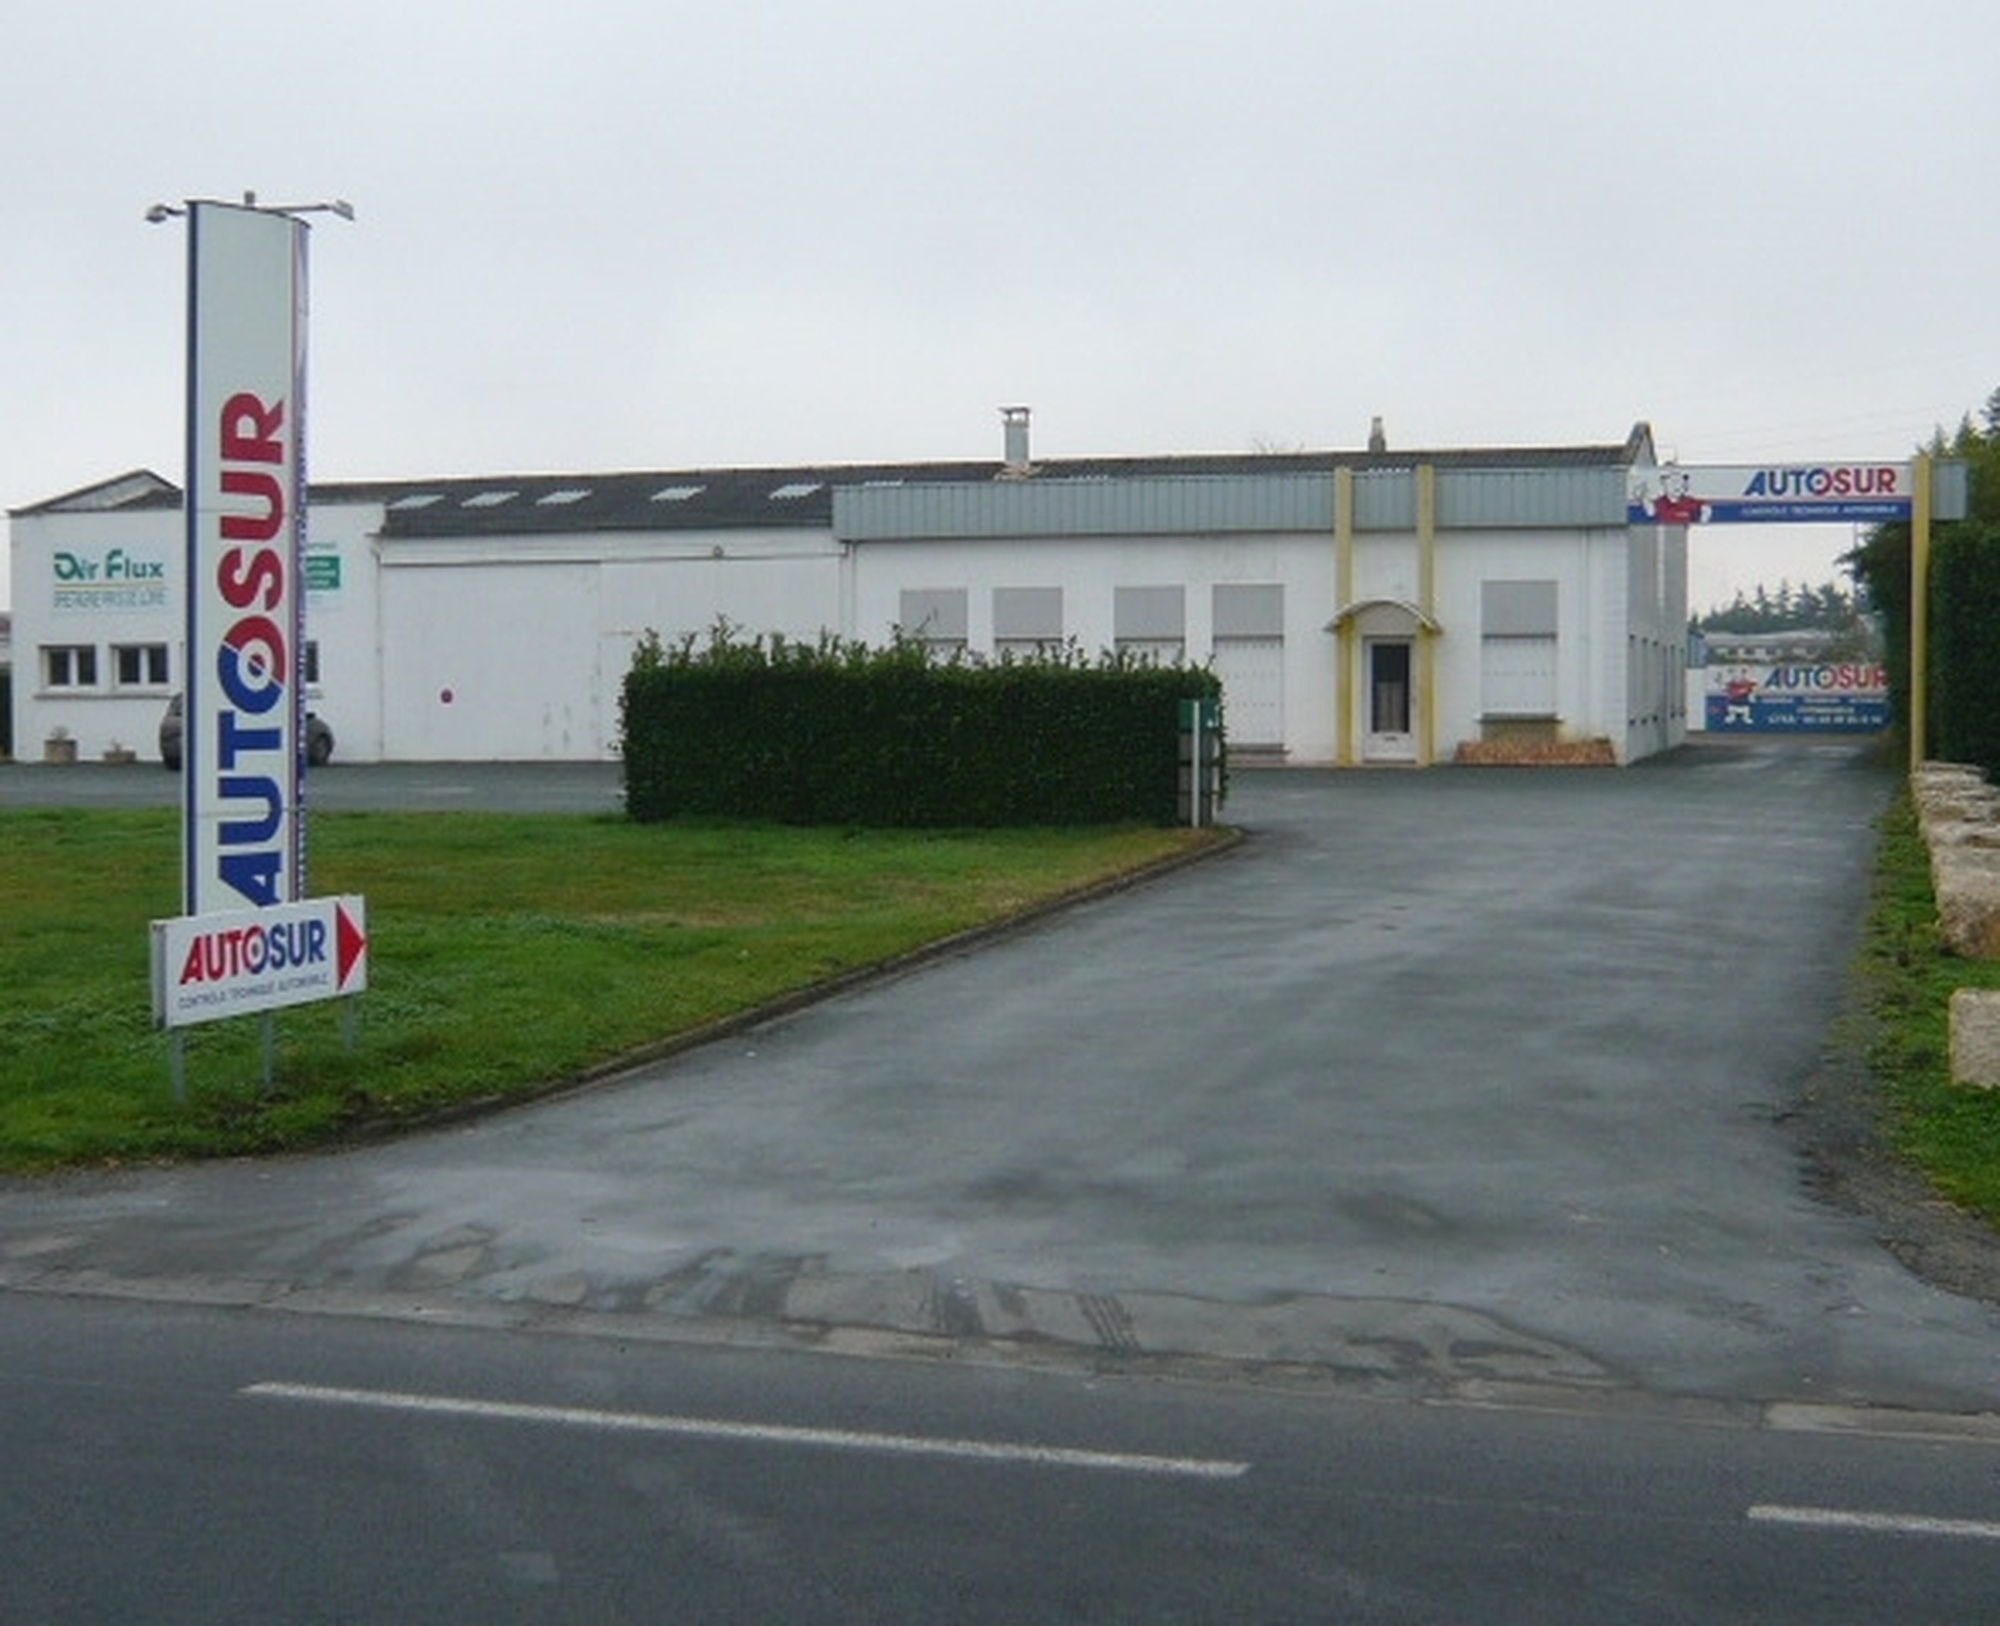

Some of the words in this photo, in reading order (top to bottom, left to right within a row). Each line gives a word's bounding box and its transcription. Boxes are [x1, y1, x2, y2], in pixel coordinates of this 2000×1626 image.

[1743, 467, 1896, 496] AUTOSUR
[106, 548, 164, 579] Flux
[217, 391, 287, 908] AUTOSUR
[179, 919, 326, 985] AUTOSUR
